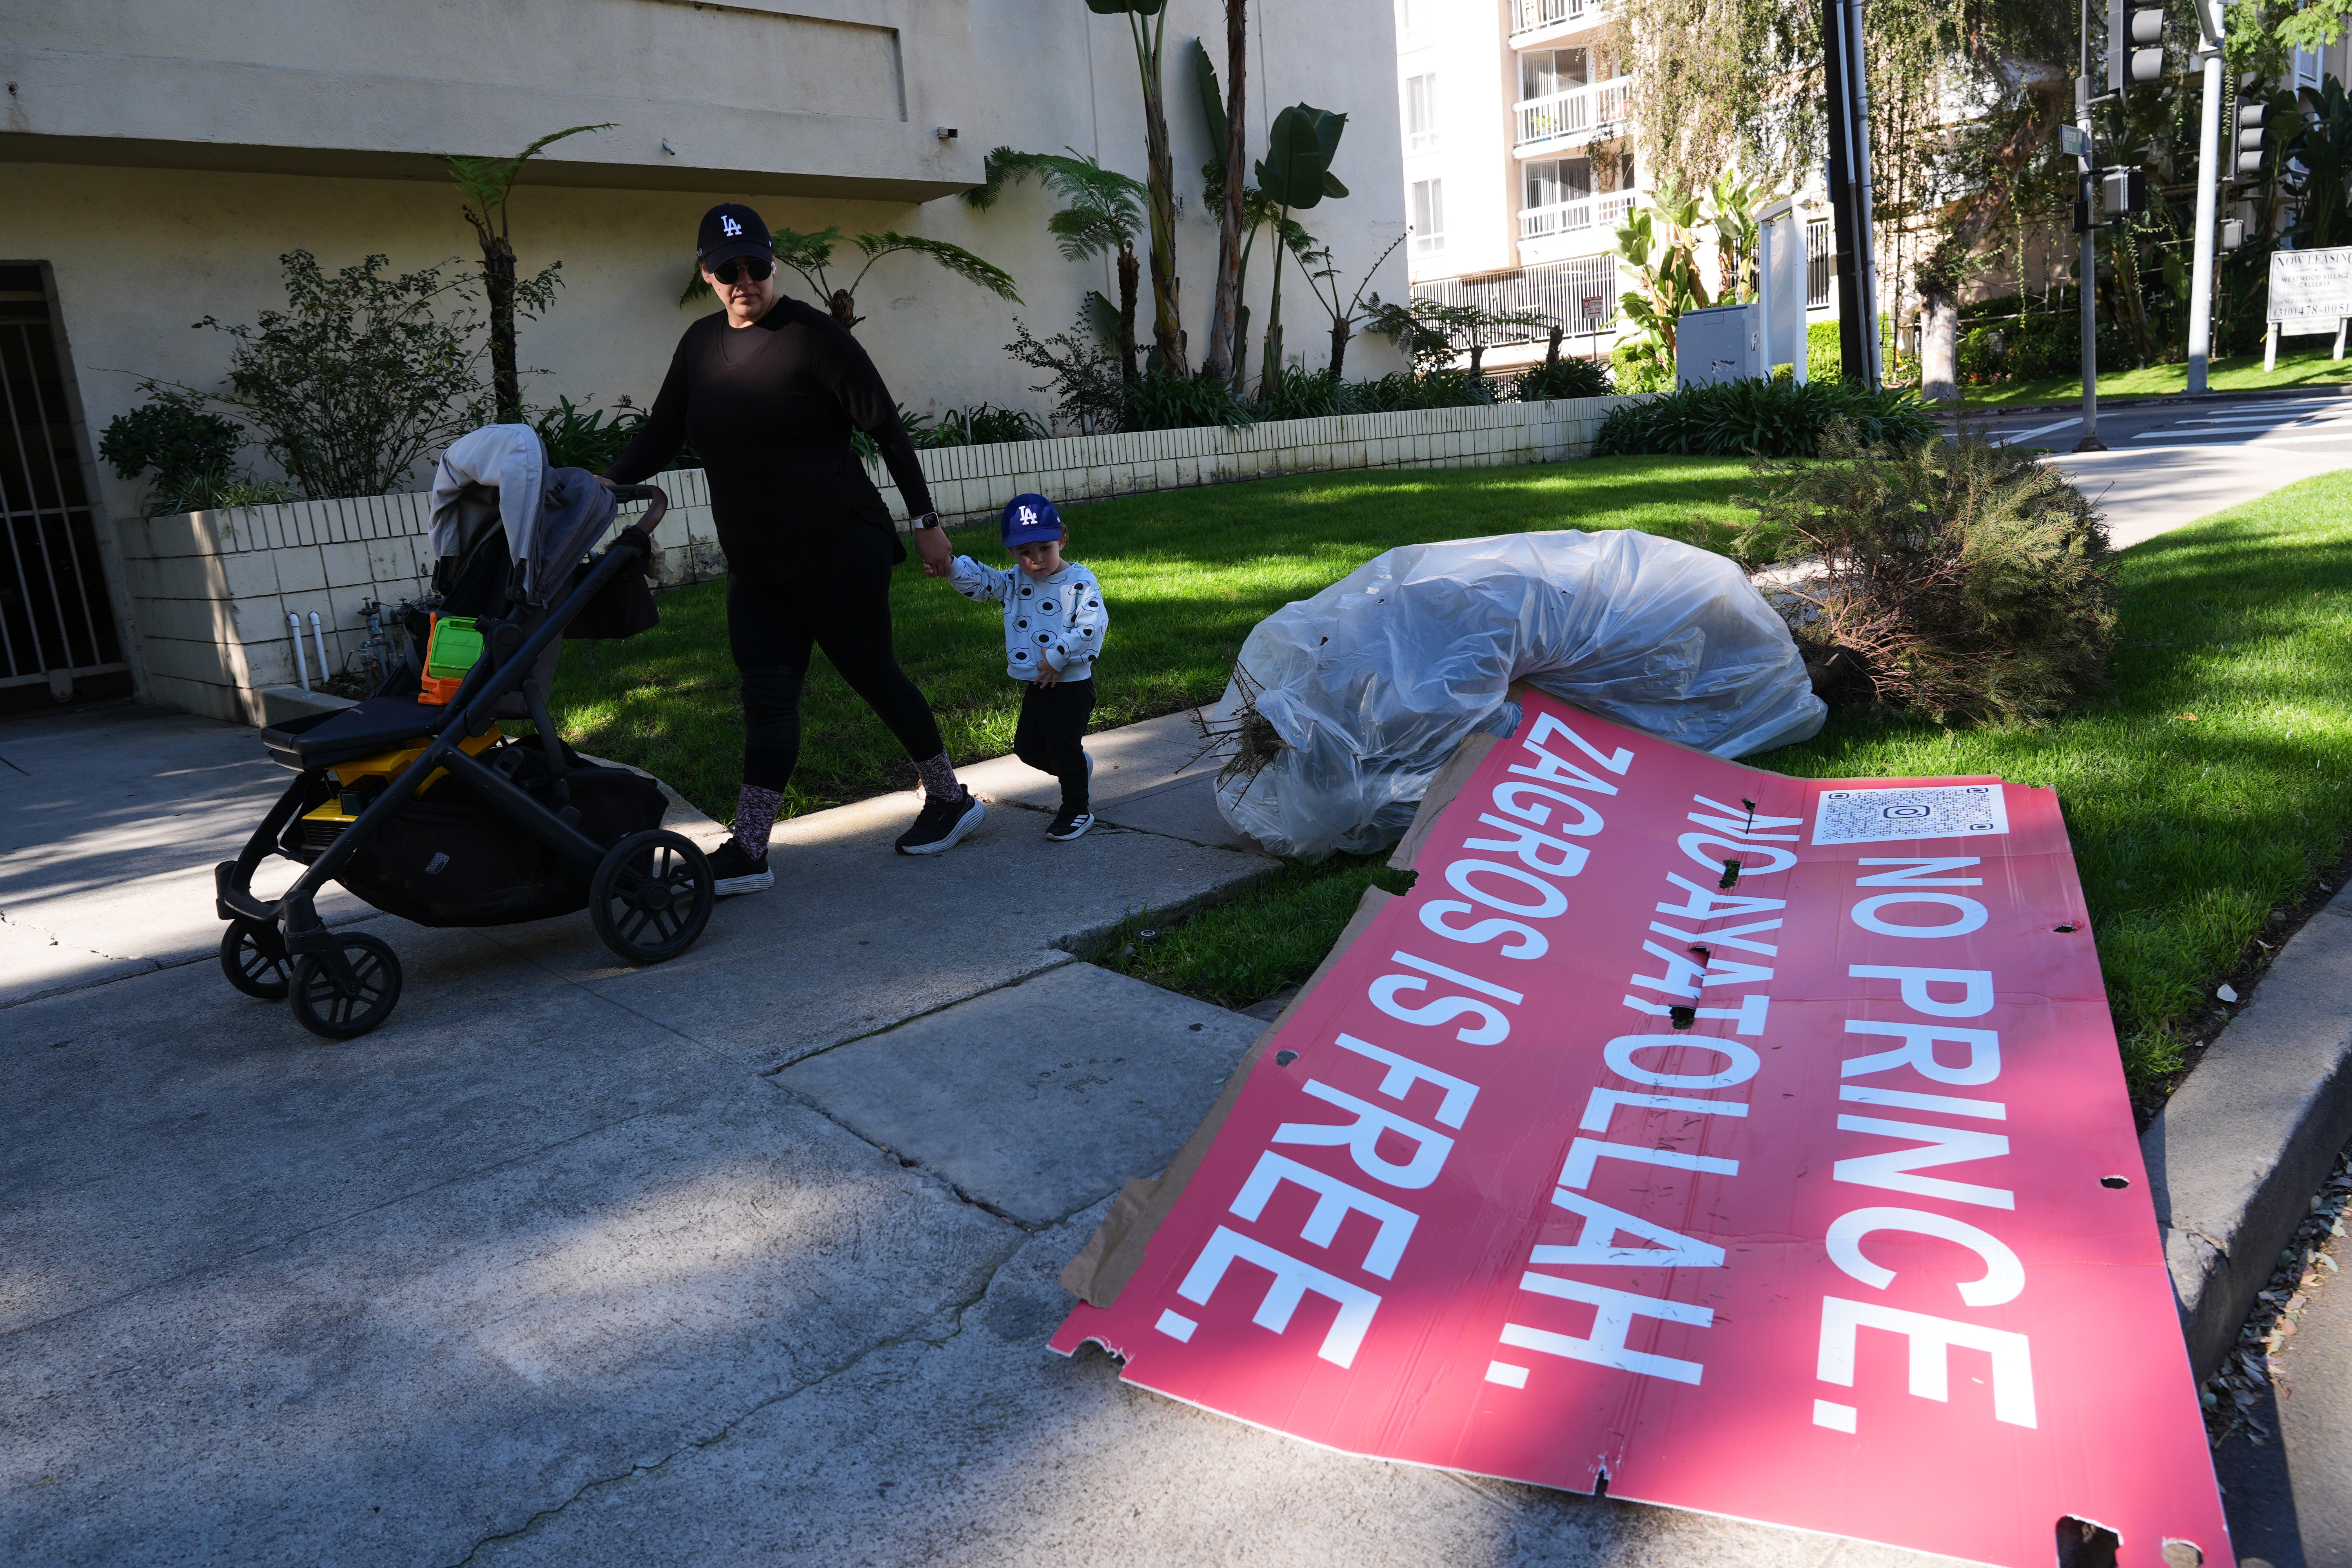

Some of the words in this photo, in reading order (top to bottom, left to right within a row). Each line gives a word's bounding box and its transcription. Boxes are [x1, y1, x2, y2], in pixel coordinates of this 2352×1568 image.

[721, 215, 742, 237] LA
[2276, 255, 2303, 269] NOW
[1018, 506, 1038, 525] LA
[585, 567, 613, 593] VISTA
[1419, 712, 1635, 960] ZAGROS
[1677, 794, 1803, 876] NO
[1851, 857, 1989, 938] NO
[1368, 950, 1524, 1045] IS
[1485, 871, 1787, 1388] AYATOLLAH.
[1155, 1033, 1480, 1368] FREE.
[1813, 964, 2037, 1434] PRINCE.
